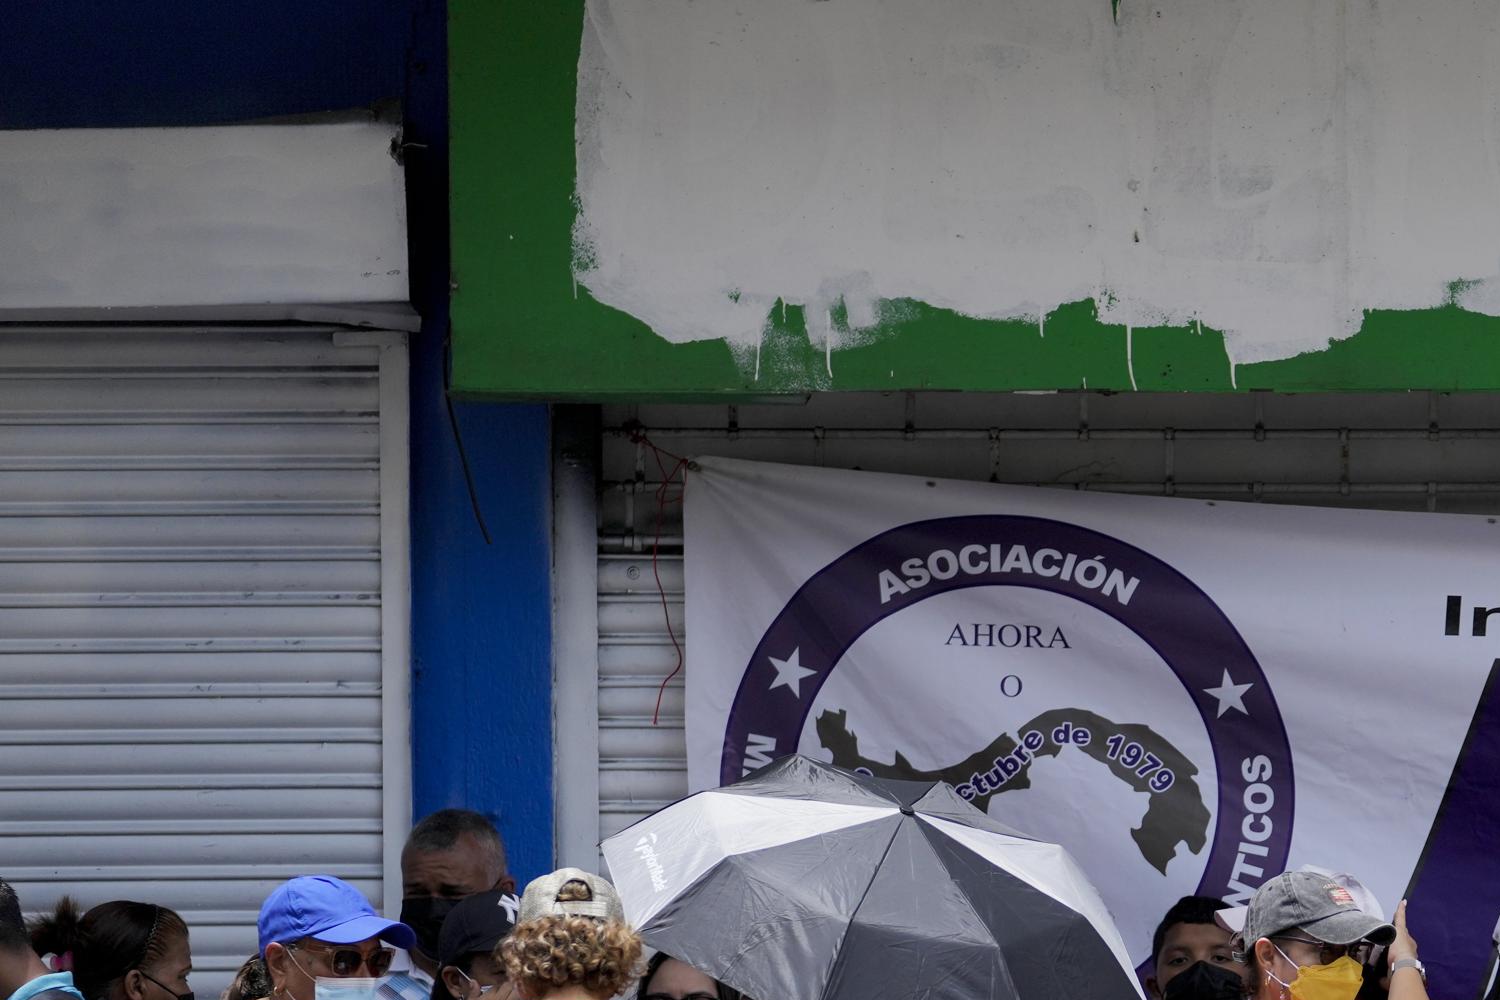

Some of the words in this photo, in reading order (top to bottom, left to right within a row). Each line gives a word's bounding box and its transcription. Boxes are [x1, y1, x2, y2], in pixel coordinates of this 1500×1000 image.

[877, 543, 1141, 605] ASOCIACIÓN
[945, 622, 1072, 650] AHORA
[999, 674, 1023, 698] O
[954, 730, 1045, 802] ctubre
[1052, 721, 1091, 746] de
[1105, 733, 1176, 793] 1979
[1221, 754, 1275, 908] NTICOS
